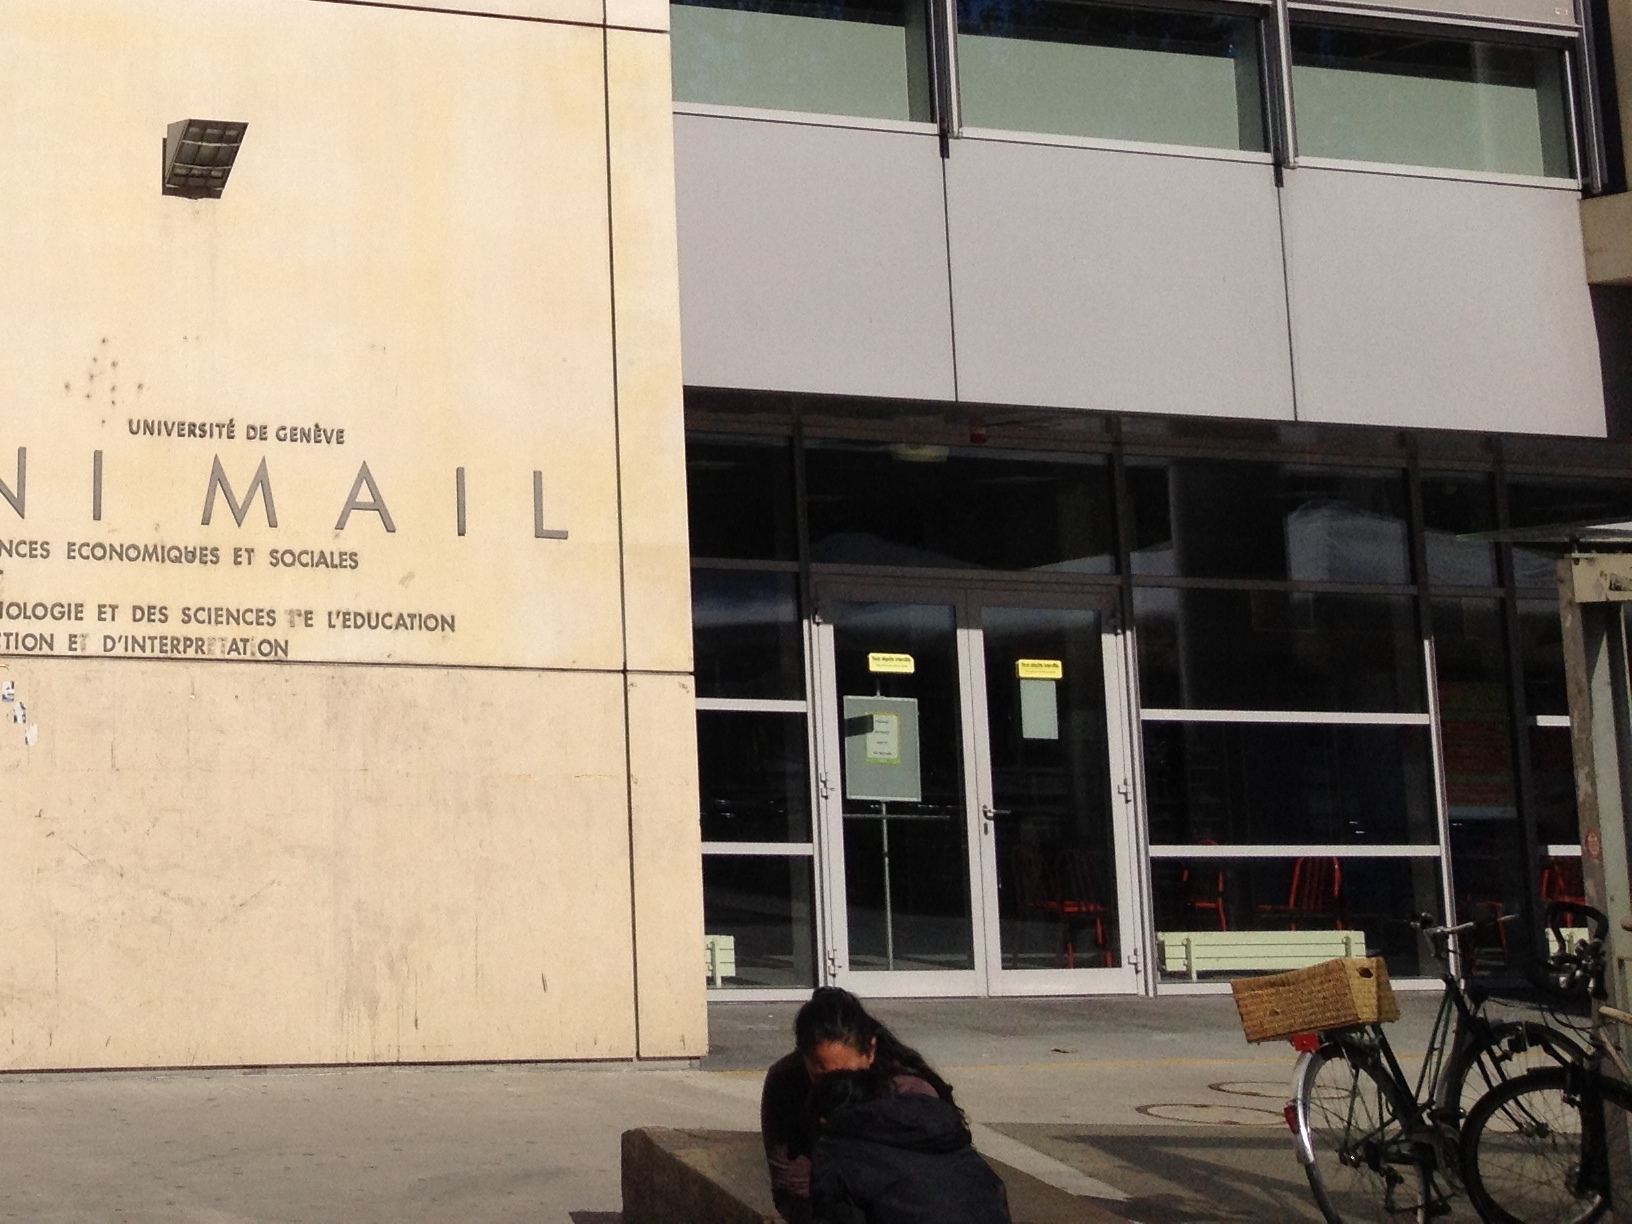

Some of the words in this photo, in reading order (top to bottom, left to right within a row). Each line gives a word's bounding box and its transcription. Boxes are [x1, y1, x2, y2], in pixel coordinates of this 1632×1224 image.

[128, 418, 236, 440] UNIVERSITÉ
[246, 423, 268, 441] DE
[275, 422, 345, 445] GENÈVE
[201, 453, 569, 540] MAIL
[66, 541, 221, 566] ECONOMIQUES
[233, 547, 255, 566] ET
[269, 548, 359, 570] SOCIALES
[97, 603, 119, 622] ET
[132, 605, 169, 624] DES
[181, 606, 277, 627] SCIENCES
[327, 610, 456, 633] L'EDUCATION
